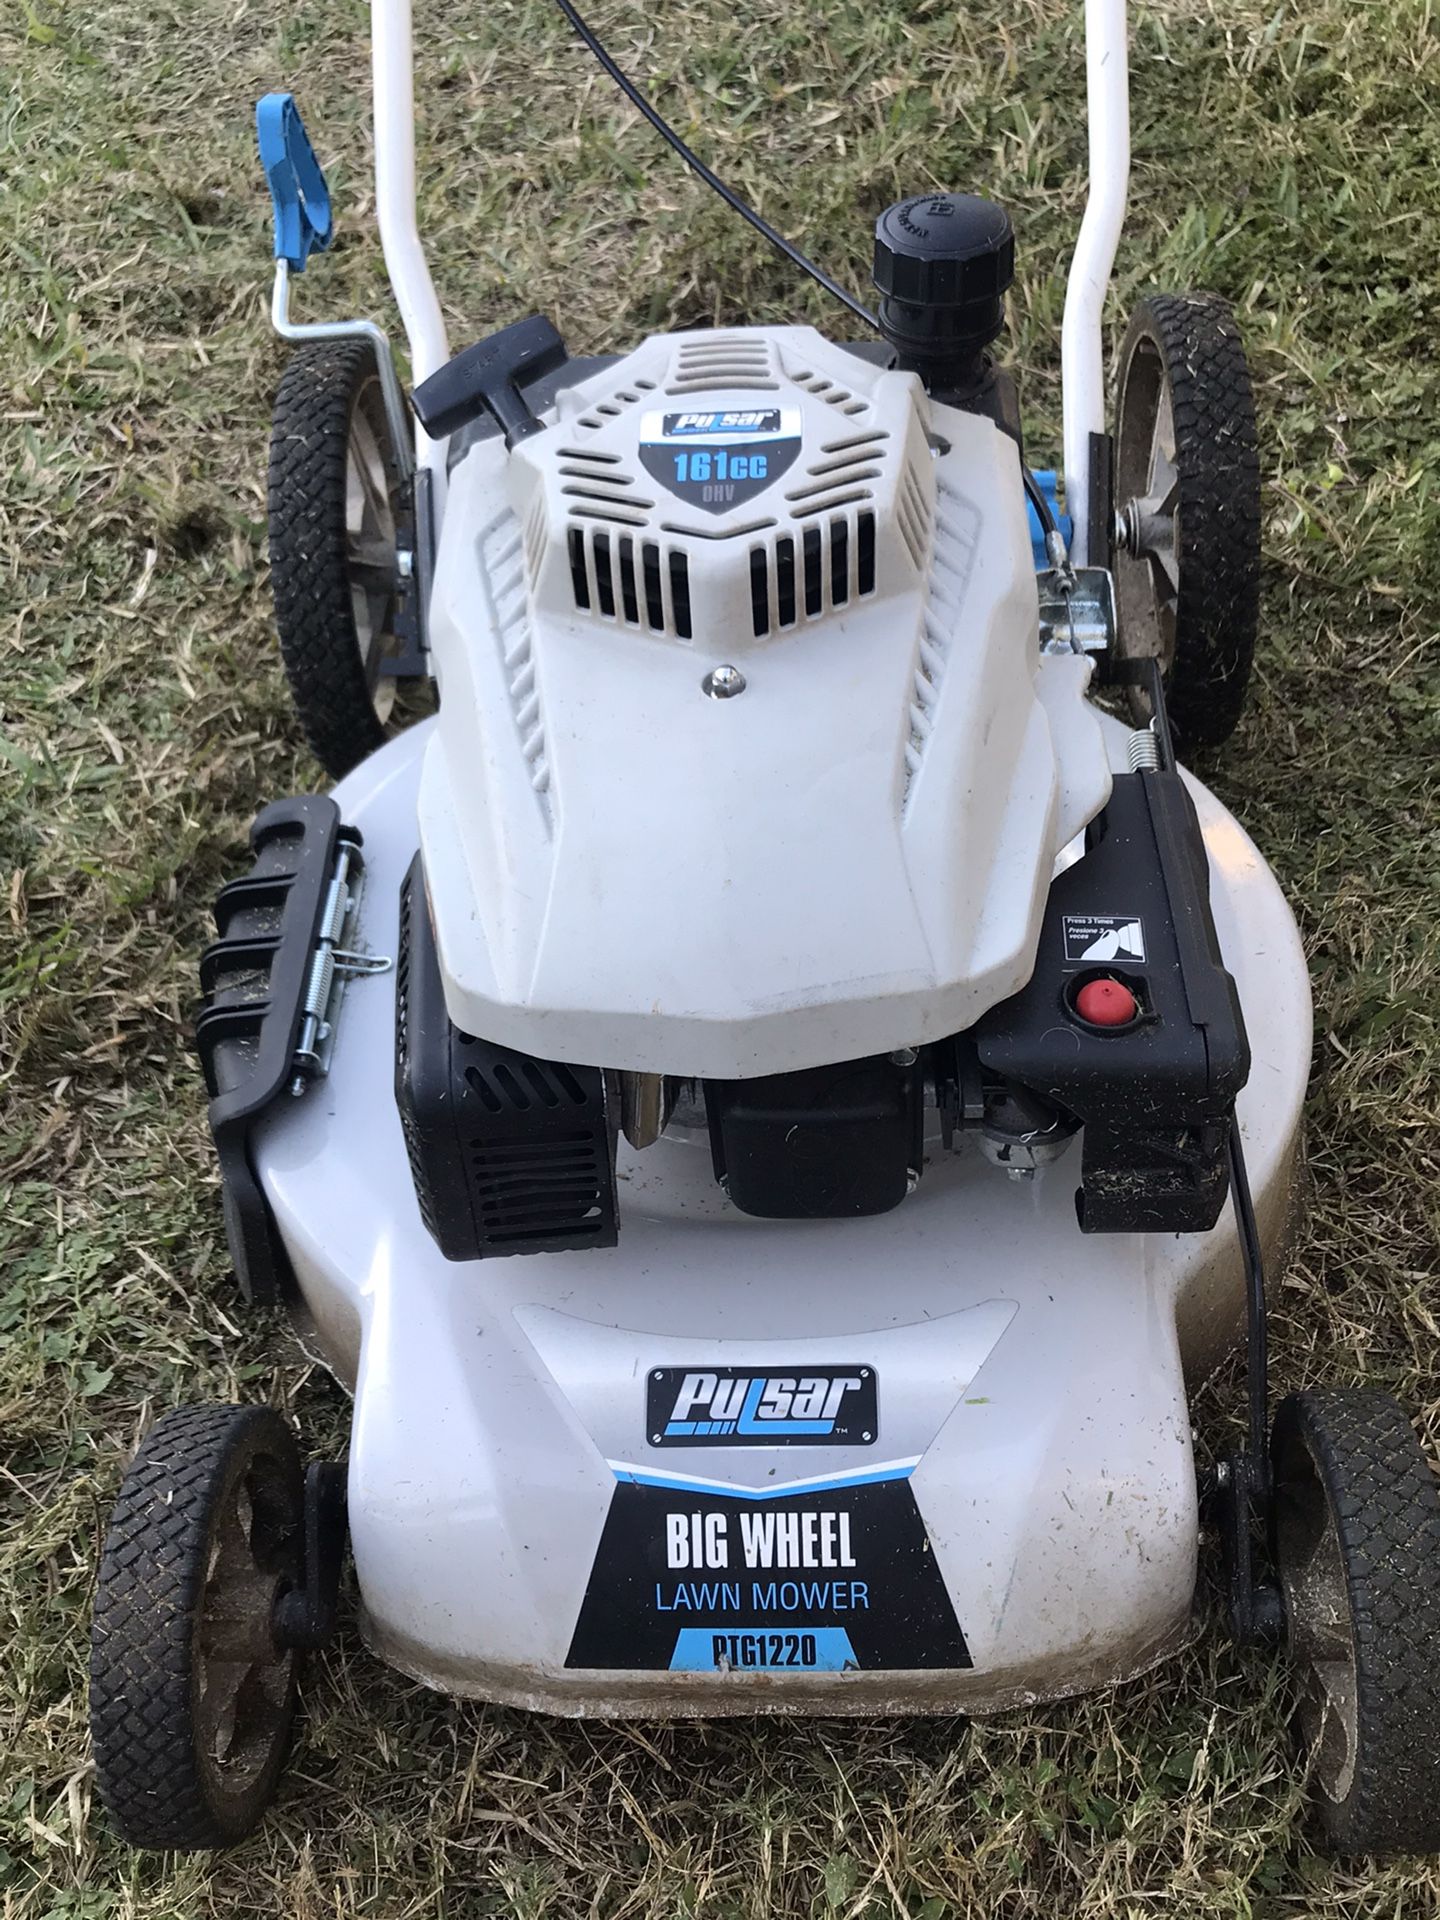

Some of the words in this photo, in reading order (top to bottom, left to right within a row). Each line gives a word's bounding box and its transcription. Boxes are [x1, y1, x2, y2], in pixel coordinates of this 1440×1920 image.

[674, 451, 768, 482] 161cc
[702, 484, 735, 502] OHV
[668, 1373, 862, 1435] Pulsar
[666, 1512, 728, 1569] BIG
[740, 1511, 857, 1568] WHEEL
[656, 1582, 740, 1611] LAWN
[752, 1581, 870, 1610] MOWER
[713, 1634, 817, 1667] PTG1220
